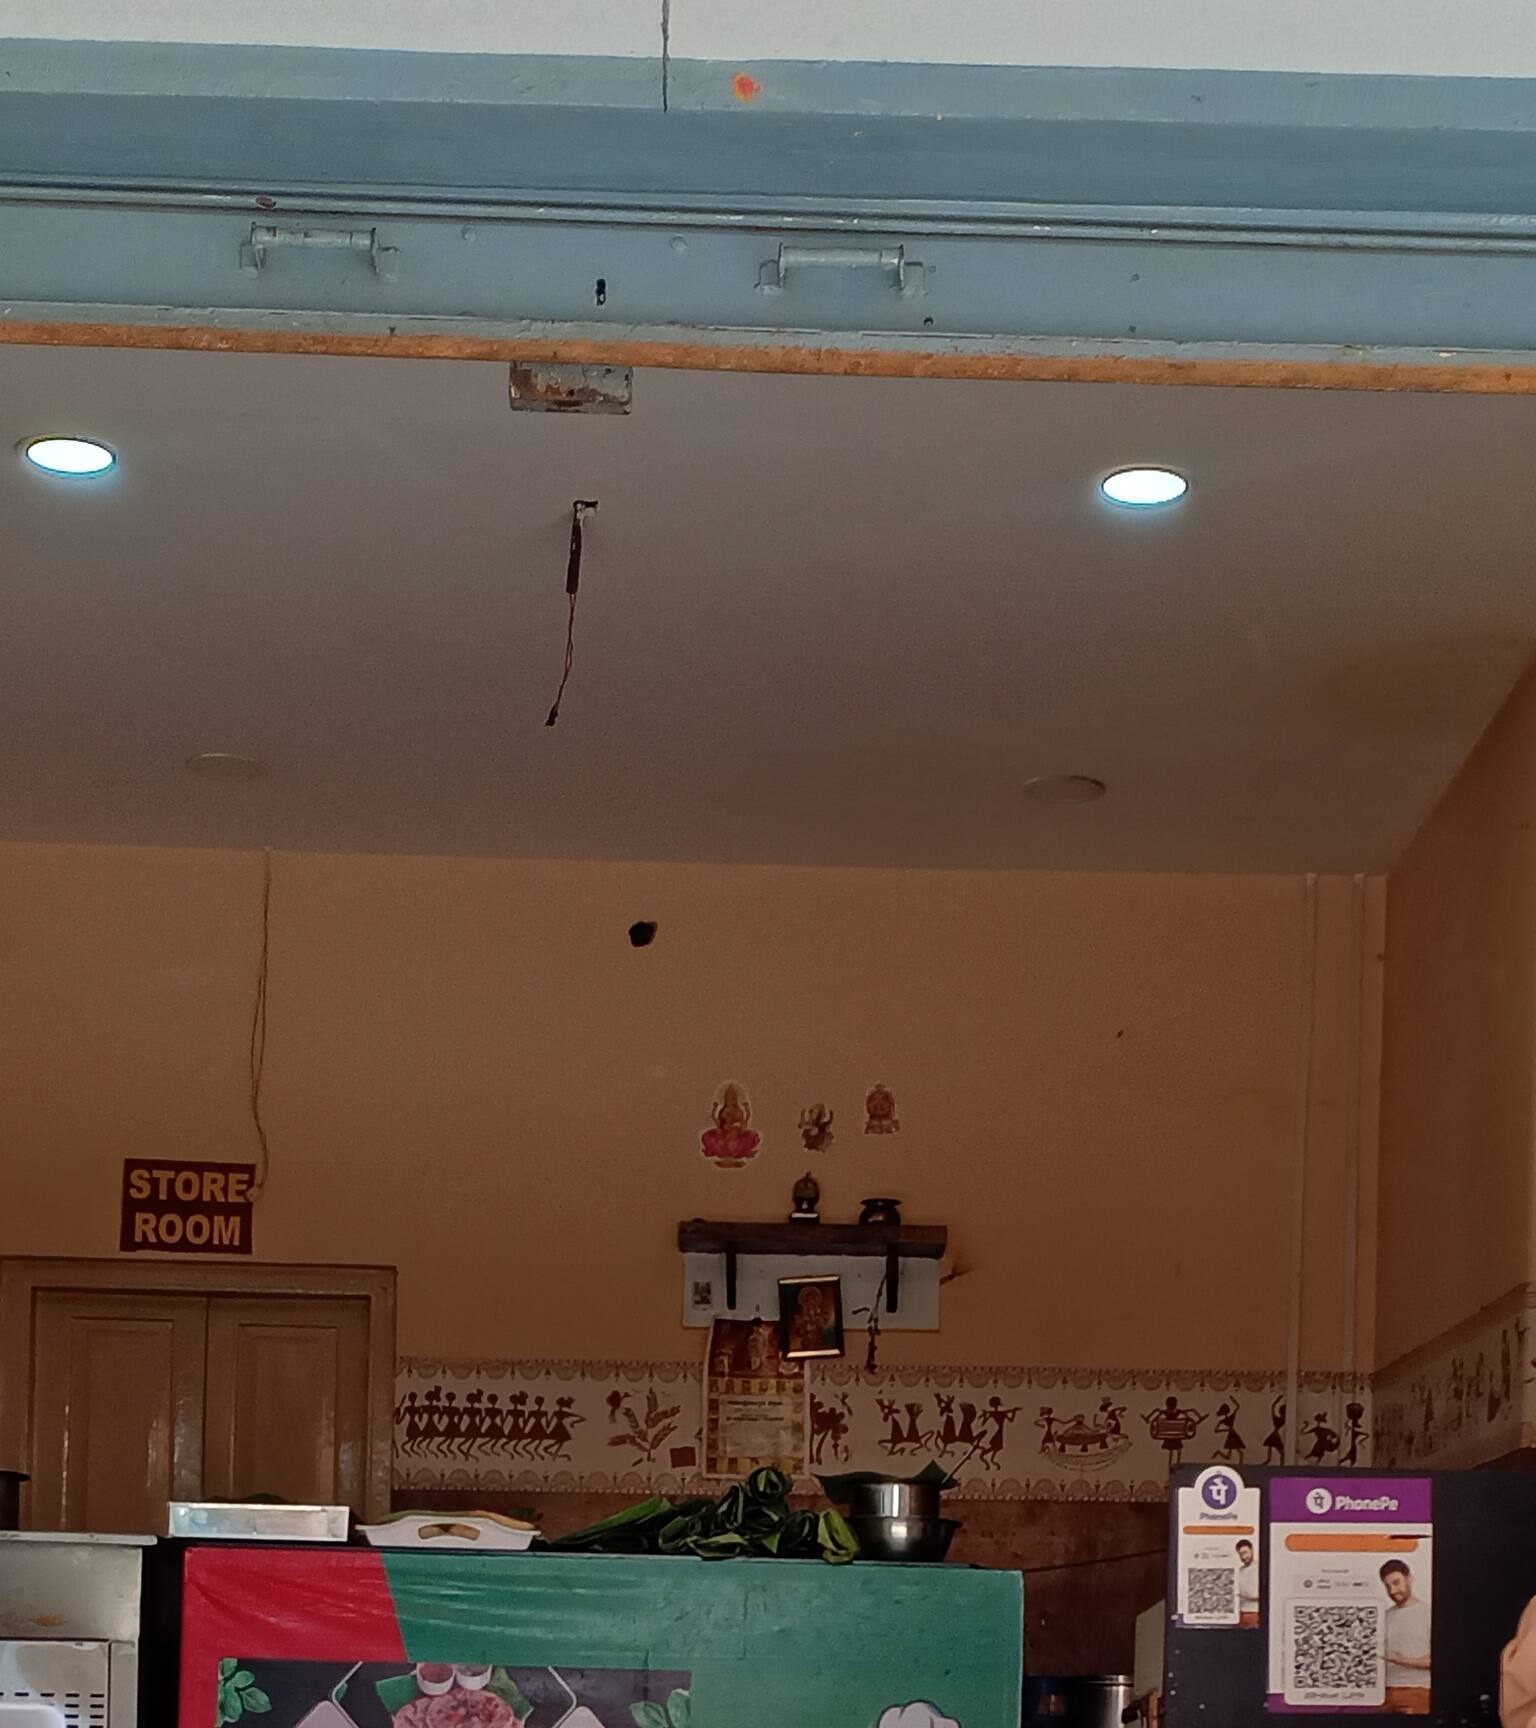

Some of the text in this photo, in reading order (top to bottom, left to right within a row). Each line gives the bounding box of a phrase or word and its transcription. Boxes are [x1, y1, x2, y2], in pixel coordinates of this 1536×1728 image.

[129, 1169, 250, 1203] STORE
[133, 1212, 242, 1247] ROOM
[1334, 1495, 1400, 1512] PhonePe
